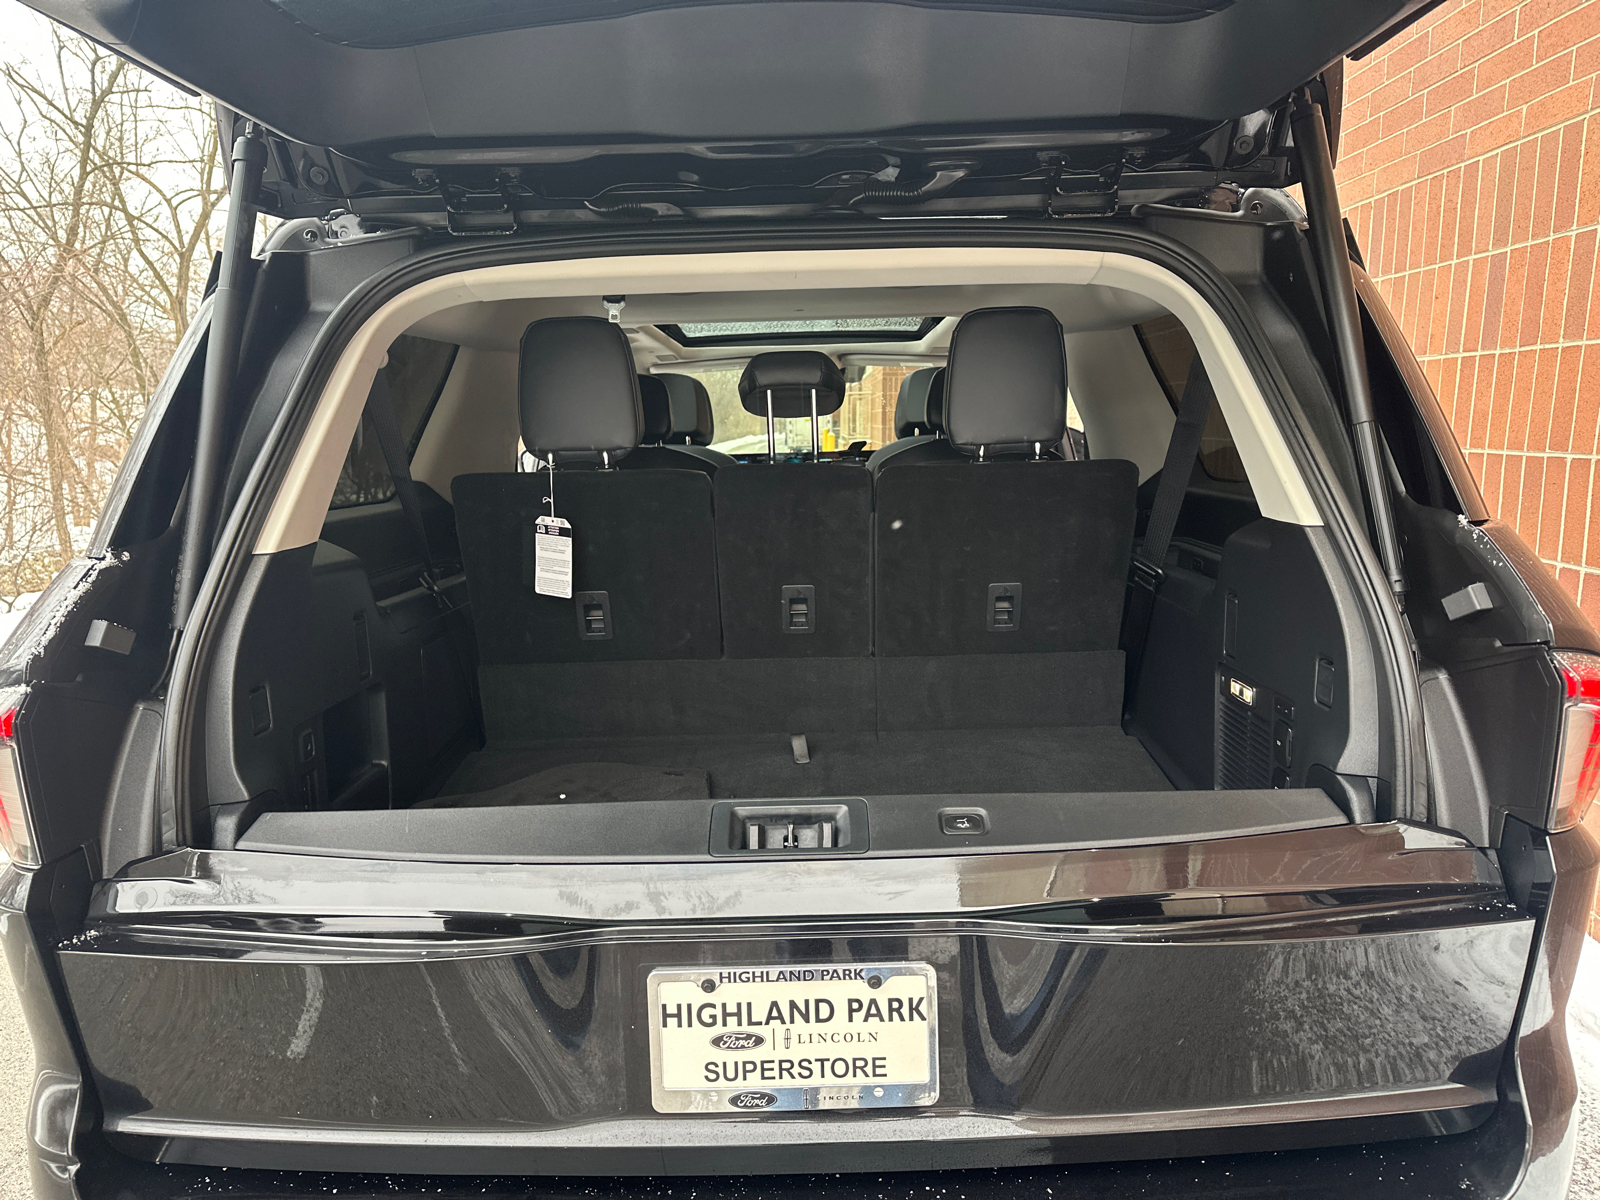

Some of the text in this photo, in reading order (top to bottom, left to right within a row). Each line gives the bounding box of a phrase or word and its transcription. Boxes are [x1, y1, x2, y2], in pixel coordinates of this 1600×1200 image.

[719, 968, 865, 984] HIGHLAND PARK
[661, 996, 928, 1028] HIGHLAND PARK
[719, 1031, 880, 1049] Ford LINCOLN
[703, 1056, 888, 1083] SUPERSTORE
[737, 1093, 769, 1107] Ford
